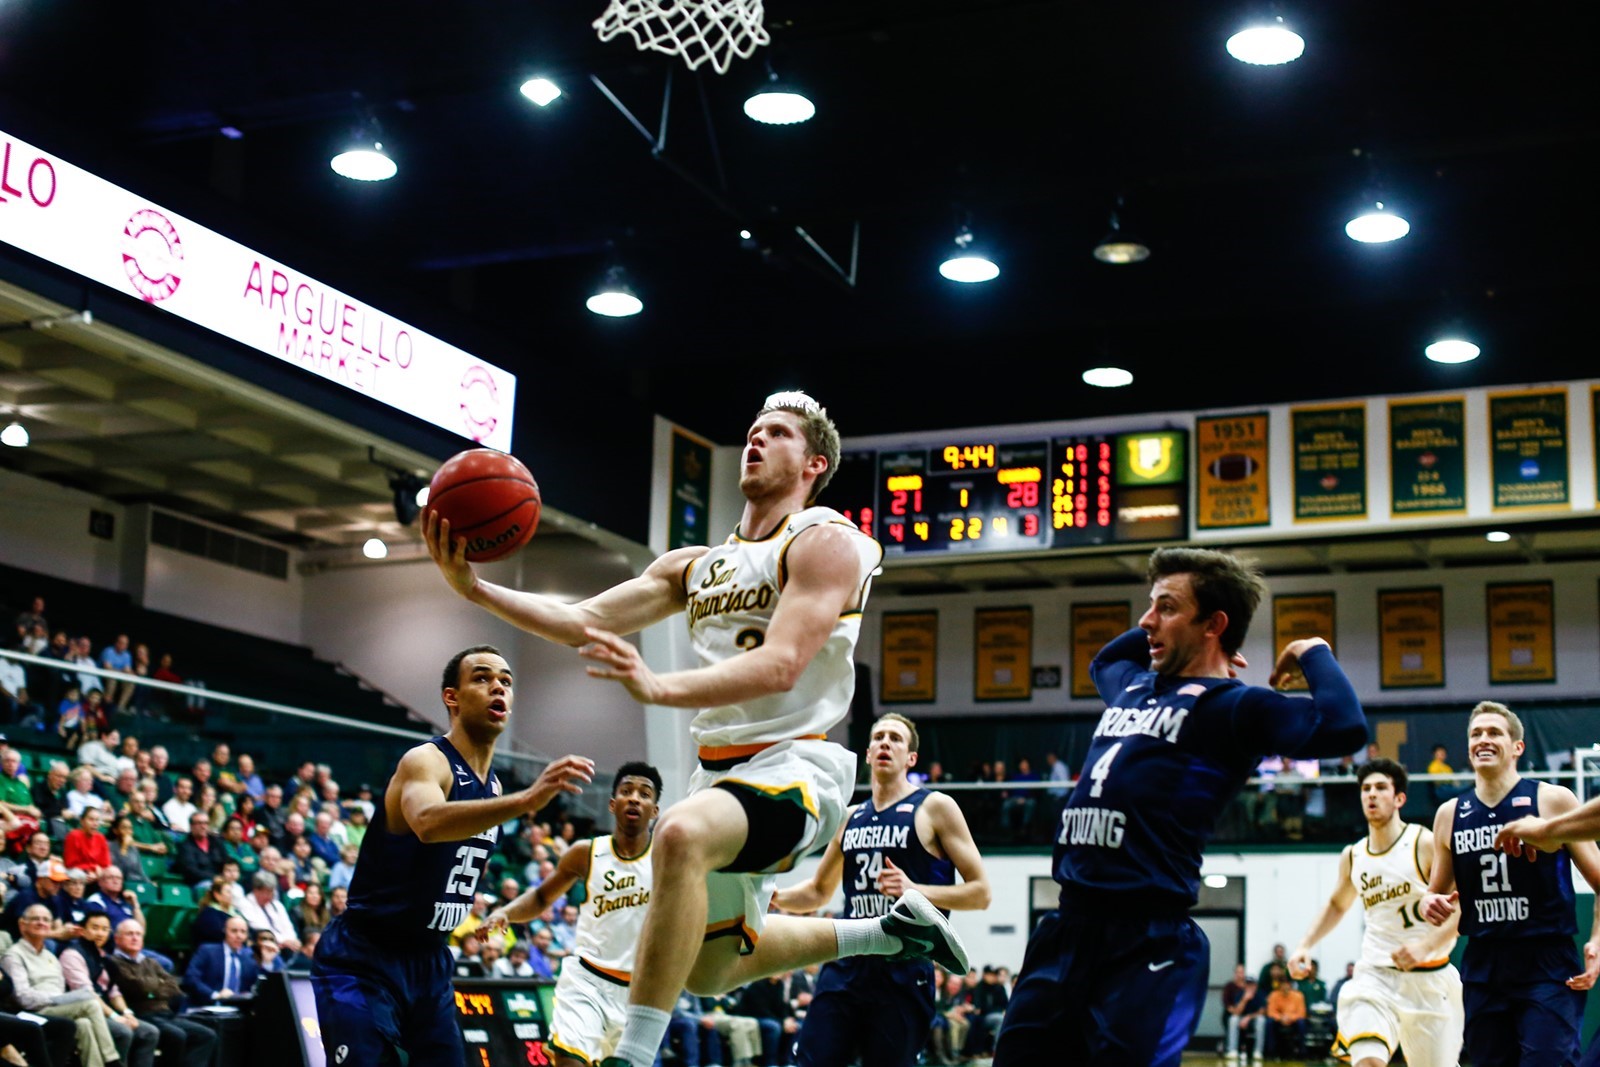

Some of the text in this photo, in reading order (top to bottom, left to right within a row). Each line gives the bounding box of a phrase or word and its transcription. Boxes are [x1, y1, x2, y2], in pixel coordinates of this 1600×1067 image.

[0, 142, 56, 208] LO
[244, 261, 412, 369] ARGUELLO
[278, 322, 380, 391] MARKET
[1213, 421, 1255, 438] 1951
[944, 445, 994, 470] 9:44
[892, 489, 922, 515] 21
[1007, 481, 1038, 509] 28
[457, 524, 521, 553] ilson
[1024, 514, 1038, 536] 3
[701, 558, 738, 589] San
[687, 584, 775, 629] Francisco
[1089, 742, 1123, 798] 4
[843, 825, 910, 852] BRIGHAM
[1058, 807, 1127, 849] YOUNG
[1454, 824, 1524, 855] BRIGH
[445, 845, 489, 897] 25
[603, 870, 636, 892] San
[854, 851, 884, 891] 34
[1360, 872, 1383, 891] San
[1479, 853, 1512, 893] 21
[1475, 896, 1530, 923] YOUNG
